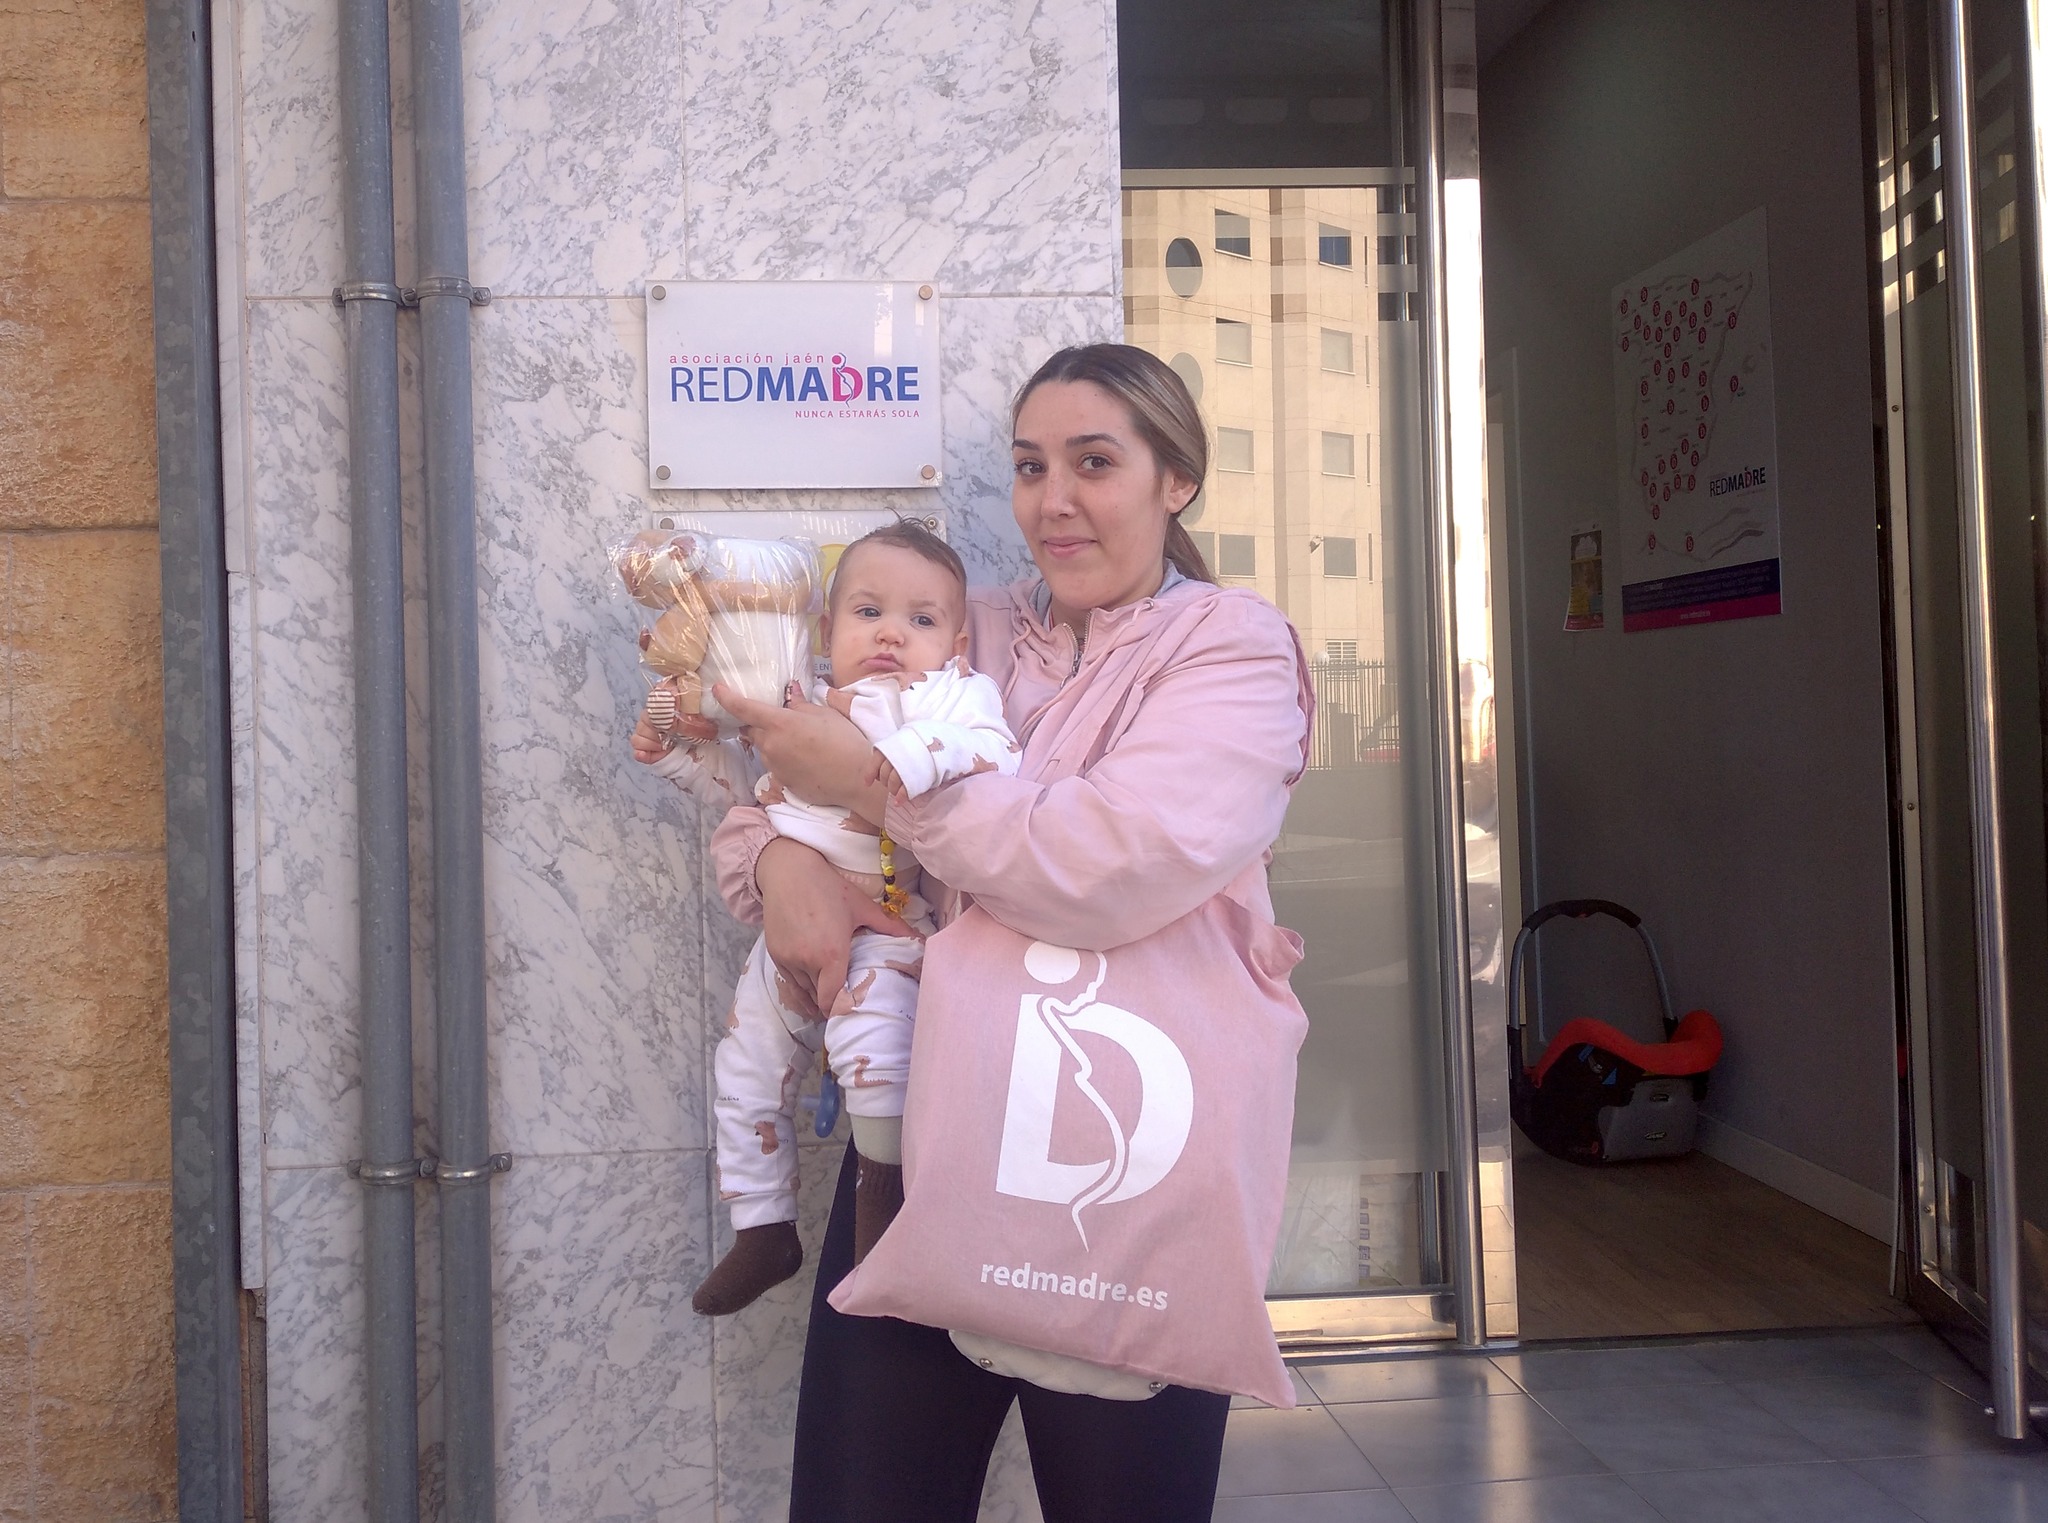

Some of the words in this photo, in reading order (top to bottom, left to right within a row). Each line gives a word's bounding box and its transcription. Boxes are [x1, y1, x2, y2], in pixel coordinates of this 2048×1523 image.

[669, 353, 774, 364] asociación
[785, 353, 824, 366] jaén
[671, 365, 920, 402] REDMADRE
[795, 410, 834, 418] NUNCA
[840, 408, 887, 418] ESTARÁS
[892, 409, 920, 418] SOLA
[1709, 467, 1766, 497] REDMADRE
[980, 1262, 1169, 1311] redmadre.es
